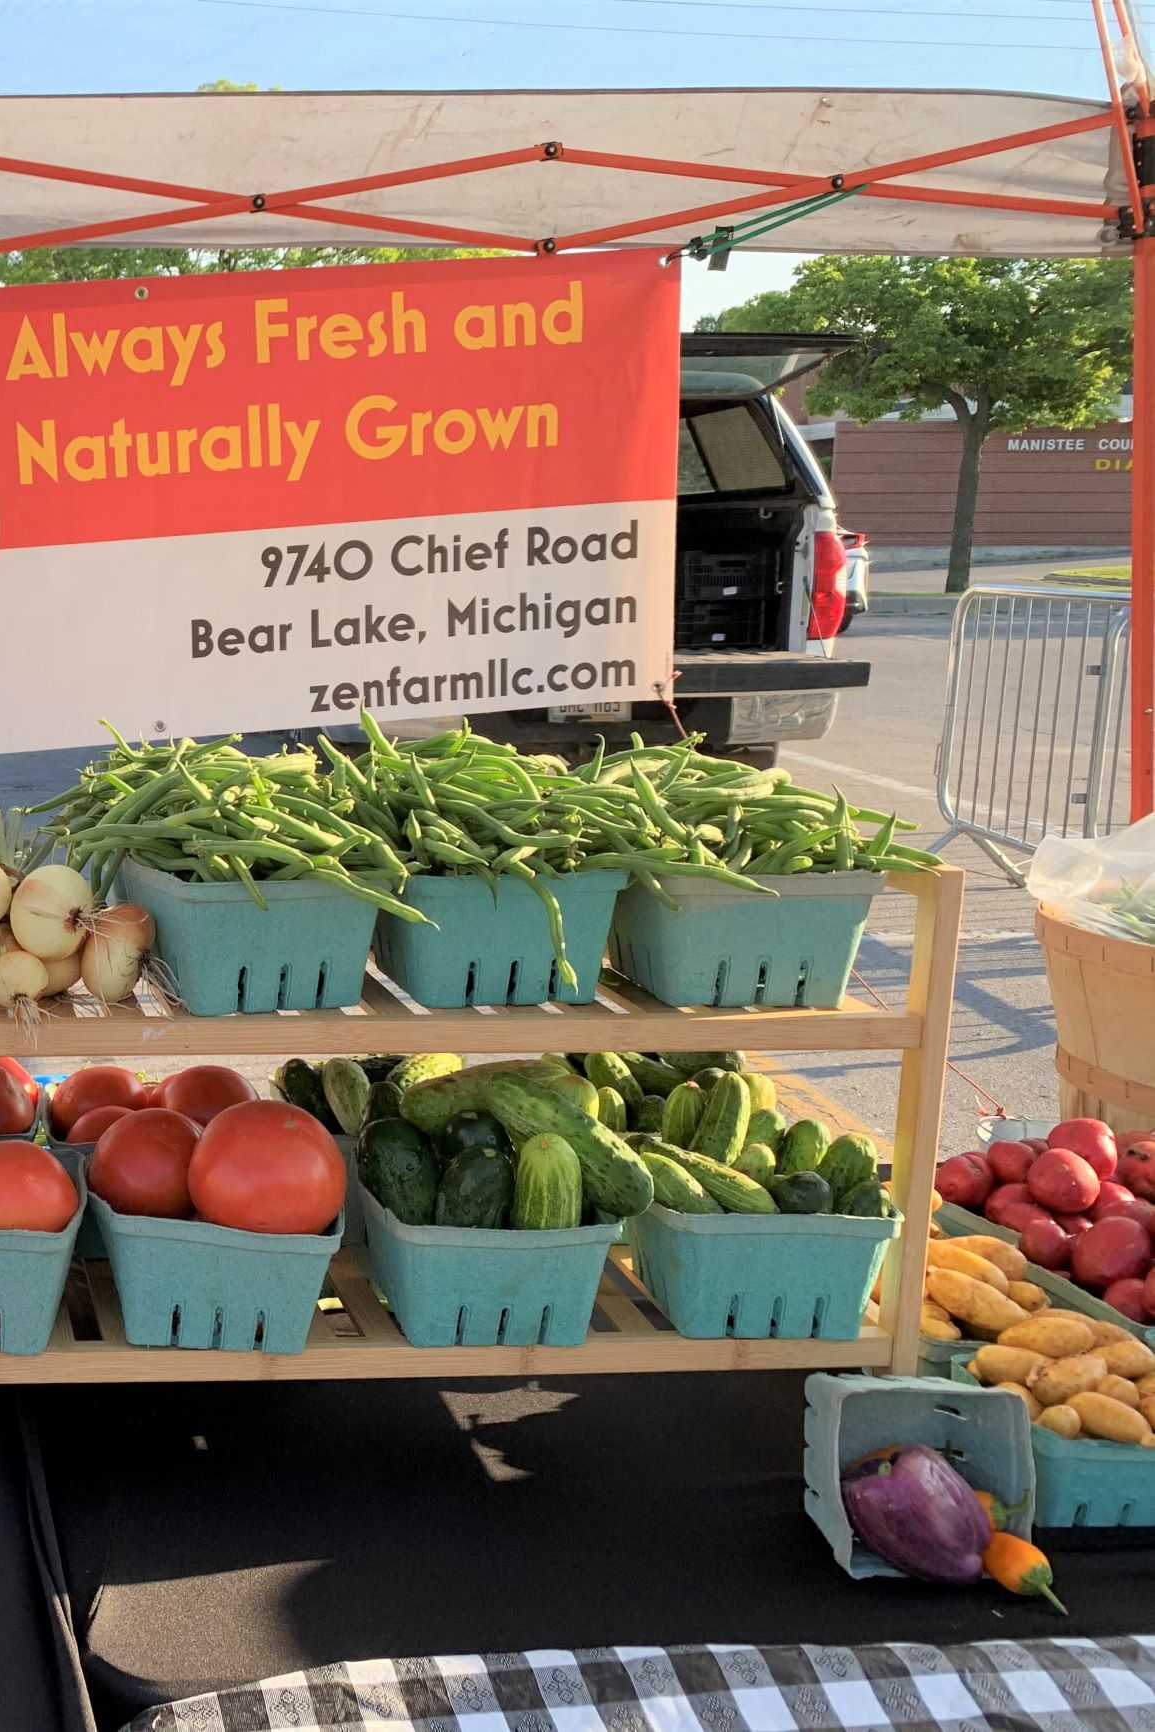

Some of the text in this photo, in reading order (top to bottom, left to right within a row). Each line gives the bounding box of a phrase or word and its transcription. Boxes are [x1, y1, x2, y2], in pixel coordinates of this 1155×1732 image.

[5, 280, 584, 387] Always Fresh and
[16, 394, 559, 485] Naturally Grown
[1007, 439, 1134, 451] MANISTEE COU
[261, 519, 638, 588] 9740 Chief Road
[191, 592, 637, 659] Bear Lake, Michigan
[309, 657, 636, 714] zenfarmllc.com
